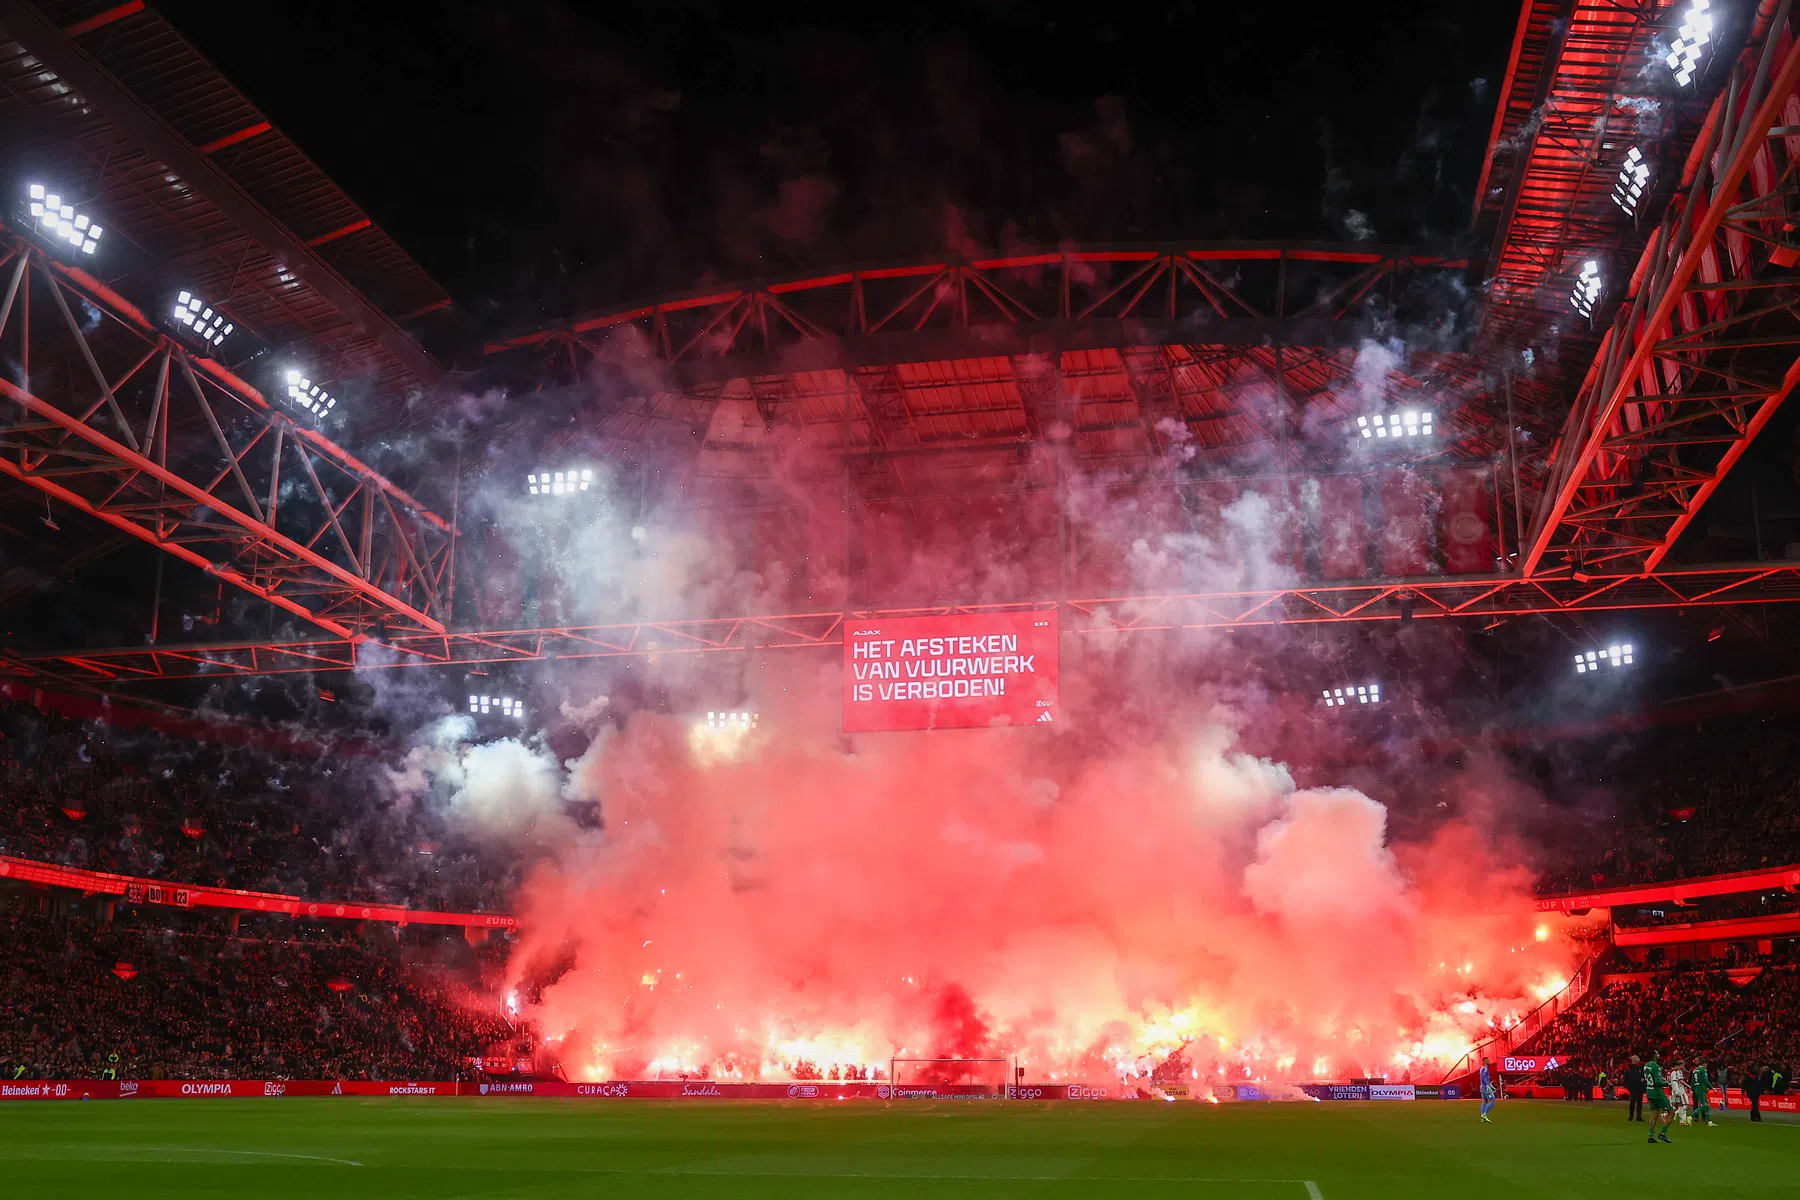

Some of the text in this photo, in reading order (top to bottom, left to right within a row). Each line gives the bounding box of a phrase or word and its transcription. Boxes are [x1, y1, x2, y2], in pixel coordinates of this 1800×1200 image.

[853, 634, 1017, 659] HET AFSTEKEN
[853, 655, 1035, 680] VAN VUURWERK
[853, 677, 1005, 701] IS VERBODEN!
[2, 1084, 40, 1096] Heineken
[120, 1081, 138, 1091] beko
[181, 1083, 232, 1096] OLYMPIA
[389, 1087, 428, 1095] ROCKSTARS
[682, 1084, 721, 1096] Sandals
[1328, 1085, 1367, 1093] VRIENDEN
[1333, 1092, 1363, 1100] LOTERIJ
